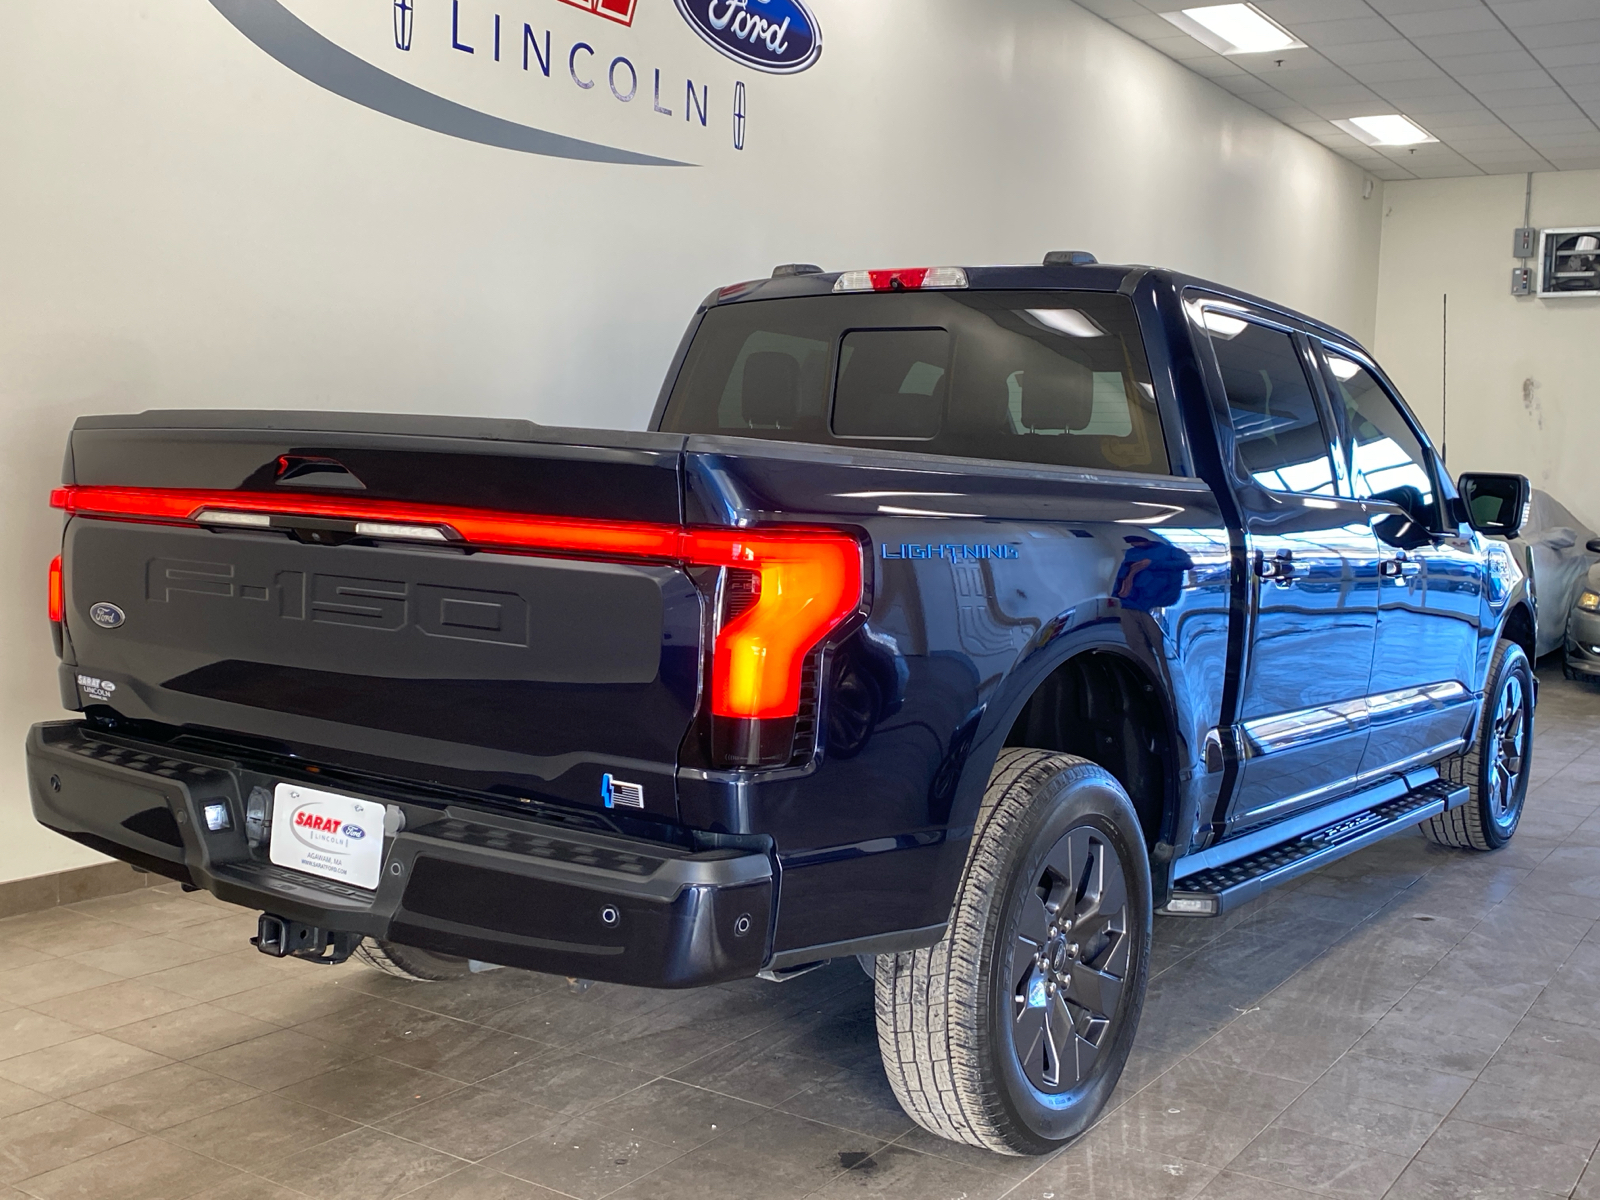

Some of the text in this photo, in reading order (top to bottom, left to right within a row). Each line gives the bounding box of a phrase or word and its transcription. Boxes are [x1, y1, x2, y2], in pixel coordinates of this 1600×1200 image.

[708, 0, 791, 55] Ford
[452, 0, 708, 127] LINCOLN
[881, 543, 1019, 564] LIGHTNING
[145, 557, 530, 648] F-150
[295, 811, 342, 834] SARAT
[344, 825, 363, 839] Ford
[315, 831, 344, 846] LINCOLN
[301, 859, 347, 875] WWW.SARATFORD.COM
[333, 857, 343, 866] MA
